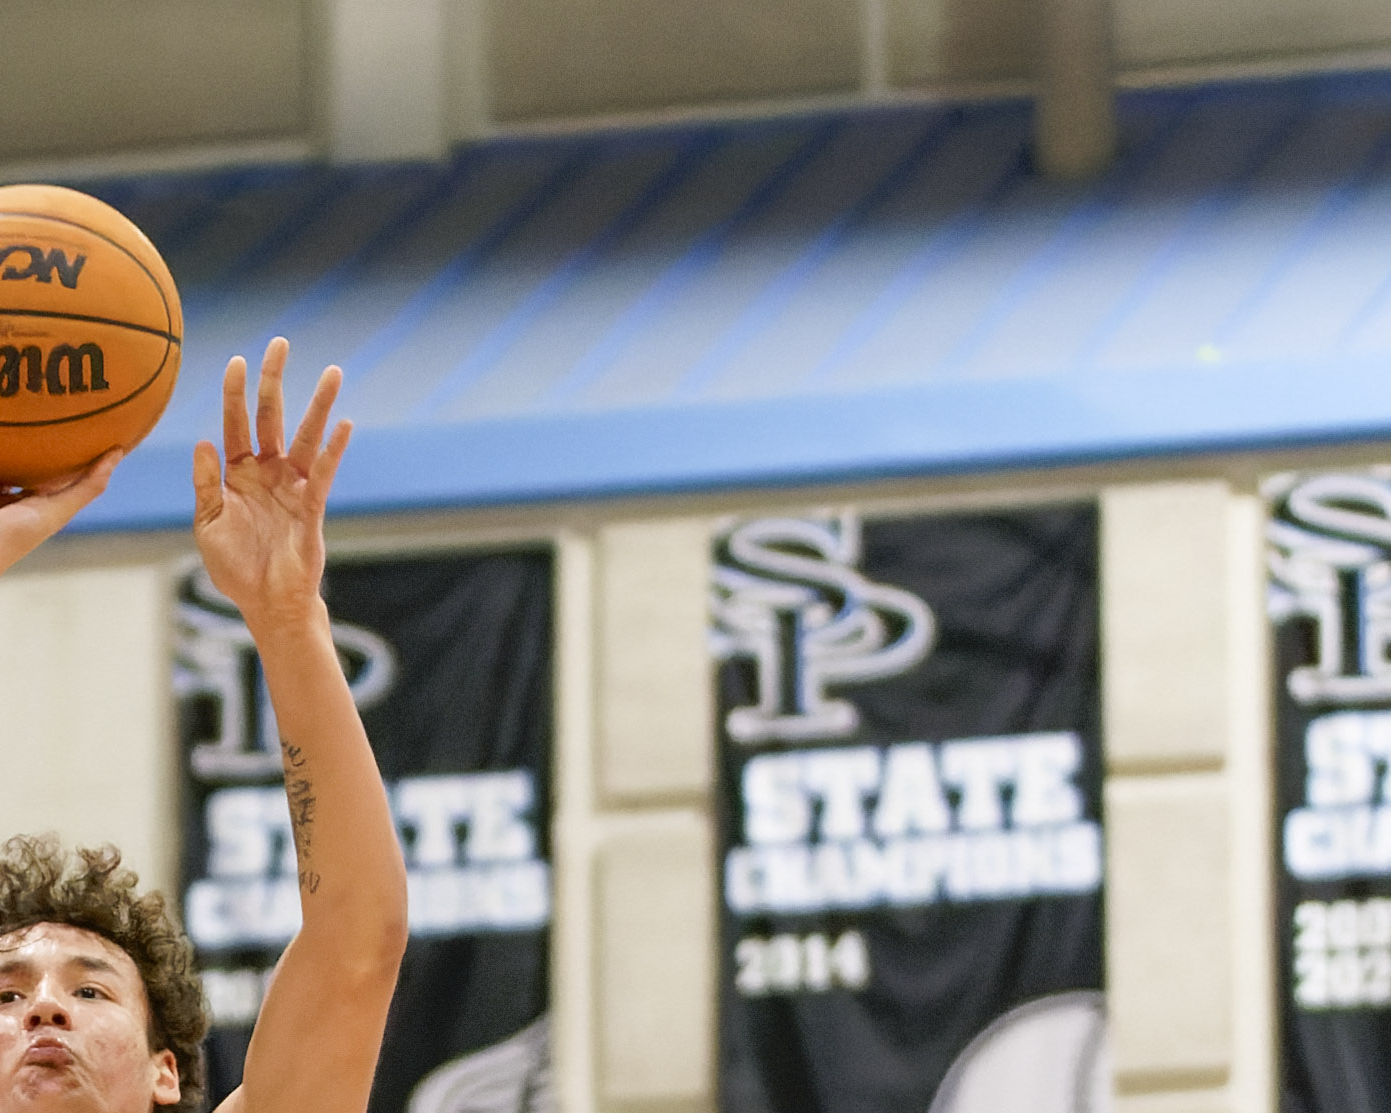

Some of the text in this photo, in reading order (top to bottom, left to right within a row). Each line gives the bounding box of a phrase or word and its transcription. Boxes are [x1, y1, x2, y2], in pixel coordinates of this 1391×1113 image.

[743, 731, 1084, 845] STATE
[724, 822, 1104, 914] CHAMPIONS
[734, 930, 868, 996] 2014
